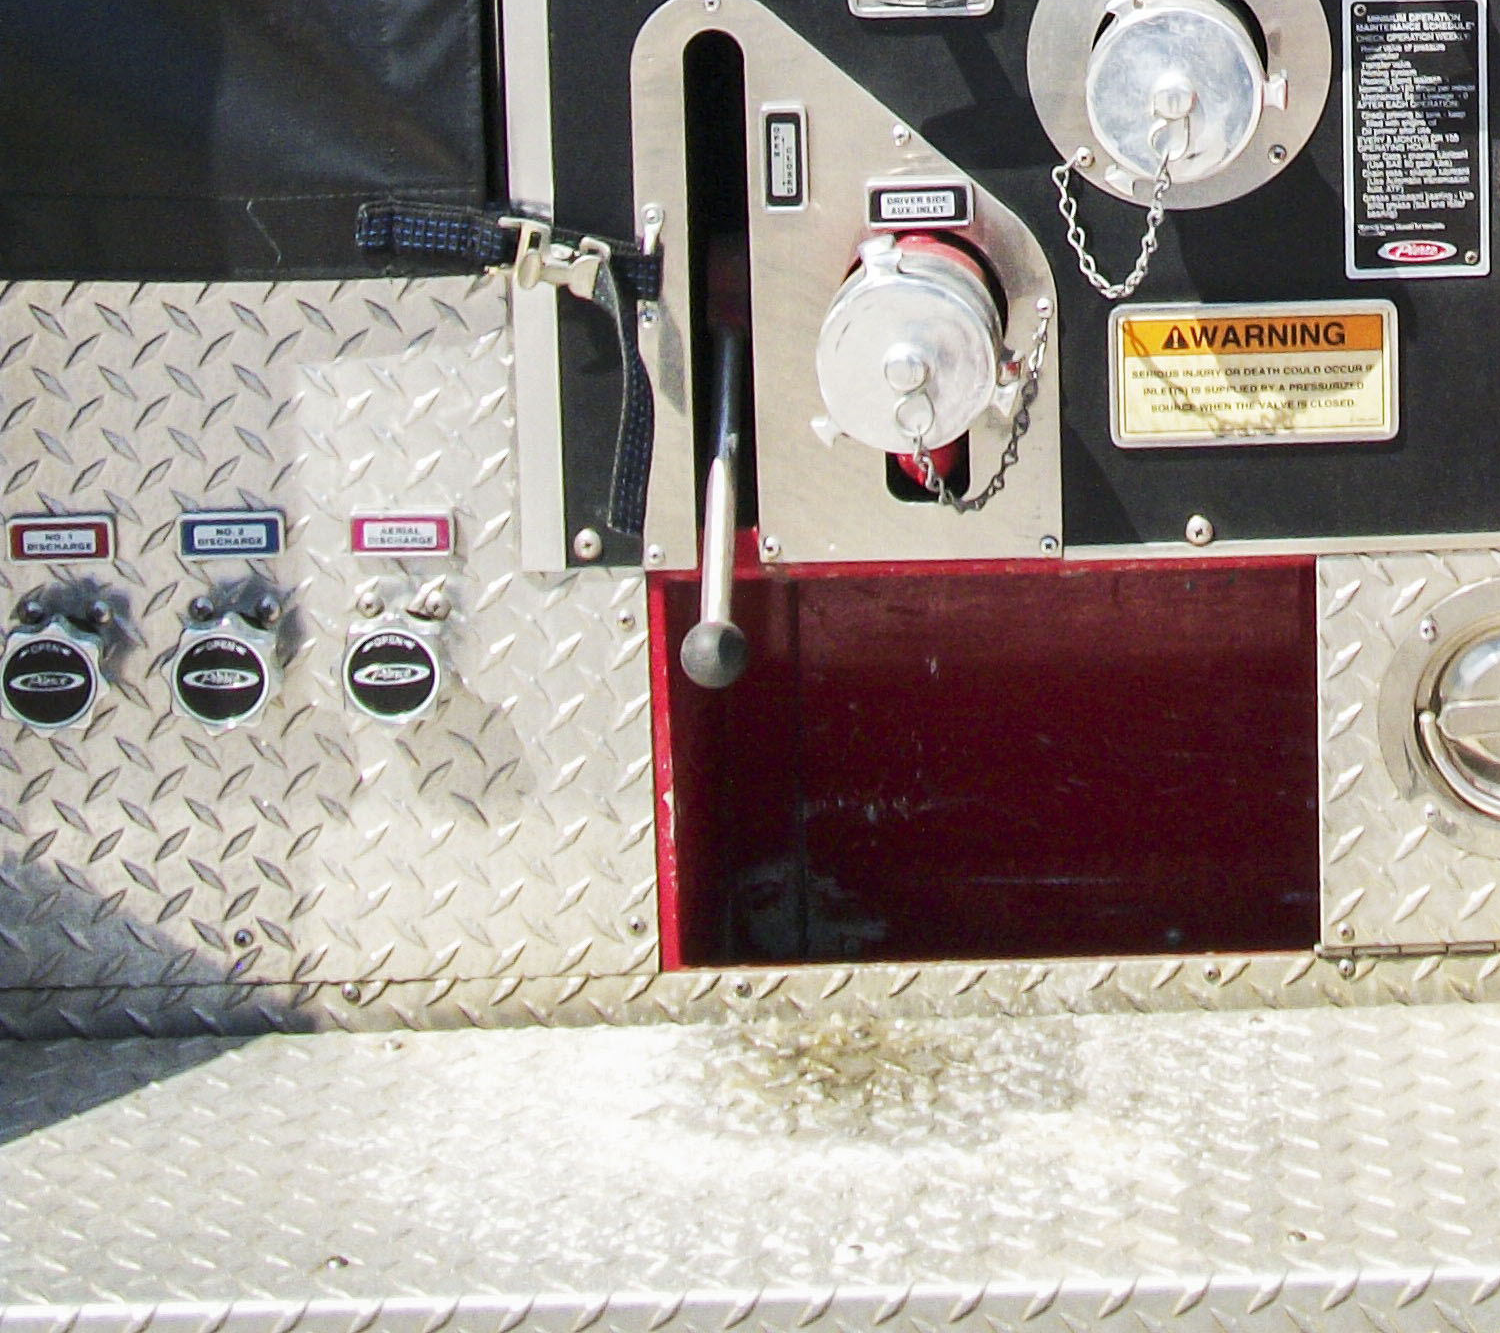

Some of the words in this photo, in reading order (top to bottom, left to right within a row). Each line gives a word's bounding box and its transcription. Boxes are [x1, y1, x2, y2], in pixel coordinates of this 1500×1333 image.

[1356, 22, 1421, 31] MAINTENANCE
[773, 126, 781, 157] OPEN
[786, 147, 794, 194] CLOSED
[887, 196, 922, 206] DRIVER
[926, 195, 948, 204] SIDE
[891, 205, 914, 215] AUX.
[917, 204, 945, 214] INLET
[1189, 321, 1346, 348] WARNING
[1132, 369, 1179, 379] SERIOUS
[1182, 368, 1220, 377] INJURY
[1224, 368, 1241, 377] OR
[1243, 367, 1280, 376] DEATH
[1283, 366, 1321, 375] COULD
[1324, 365, 1364, 374] OCCUR
[1190, 385, 1202, 394] IS
[1204, 384, 1257, 394] SUPPLIED
[1260, 383, 1276, 392] BY
[1278, 383, 1286, 391] A
[1288, 381, 1364, 391] PRESSURIZED
[1151, 403, 1197, 413] SOURCE
[1200, 401, 1232, 411] WHEN
[1235, 401, 1254, 410] THE
[1258, 400, 1294, 410] VALVE
[1297, 399, 1308, 408] IS
[1309, 398, 1354, 408] CLOSED
[216, 528, 235, 536] NO.
[238, 527, 245, 535] 2
[379, 527, 420, 535] AERIAL
[44, 533, 64, 541] NO.
[198, 537, 263, 547] DISCHARGE
[367, 537, 434, 546] DISCHARGE
[26, 542, 93, 552] DISCHARGE
[206, 639, 235, 651] OPEN
[373, 637, 405, 648] OPEN
[30, 644, 60, 654] OPEN
